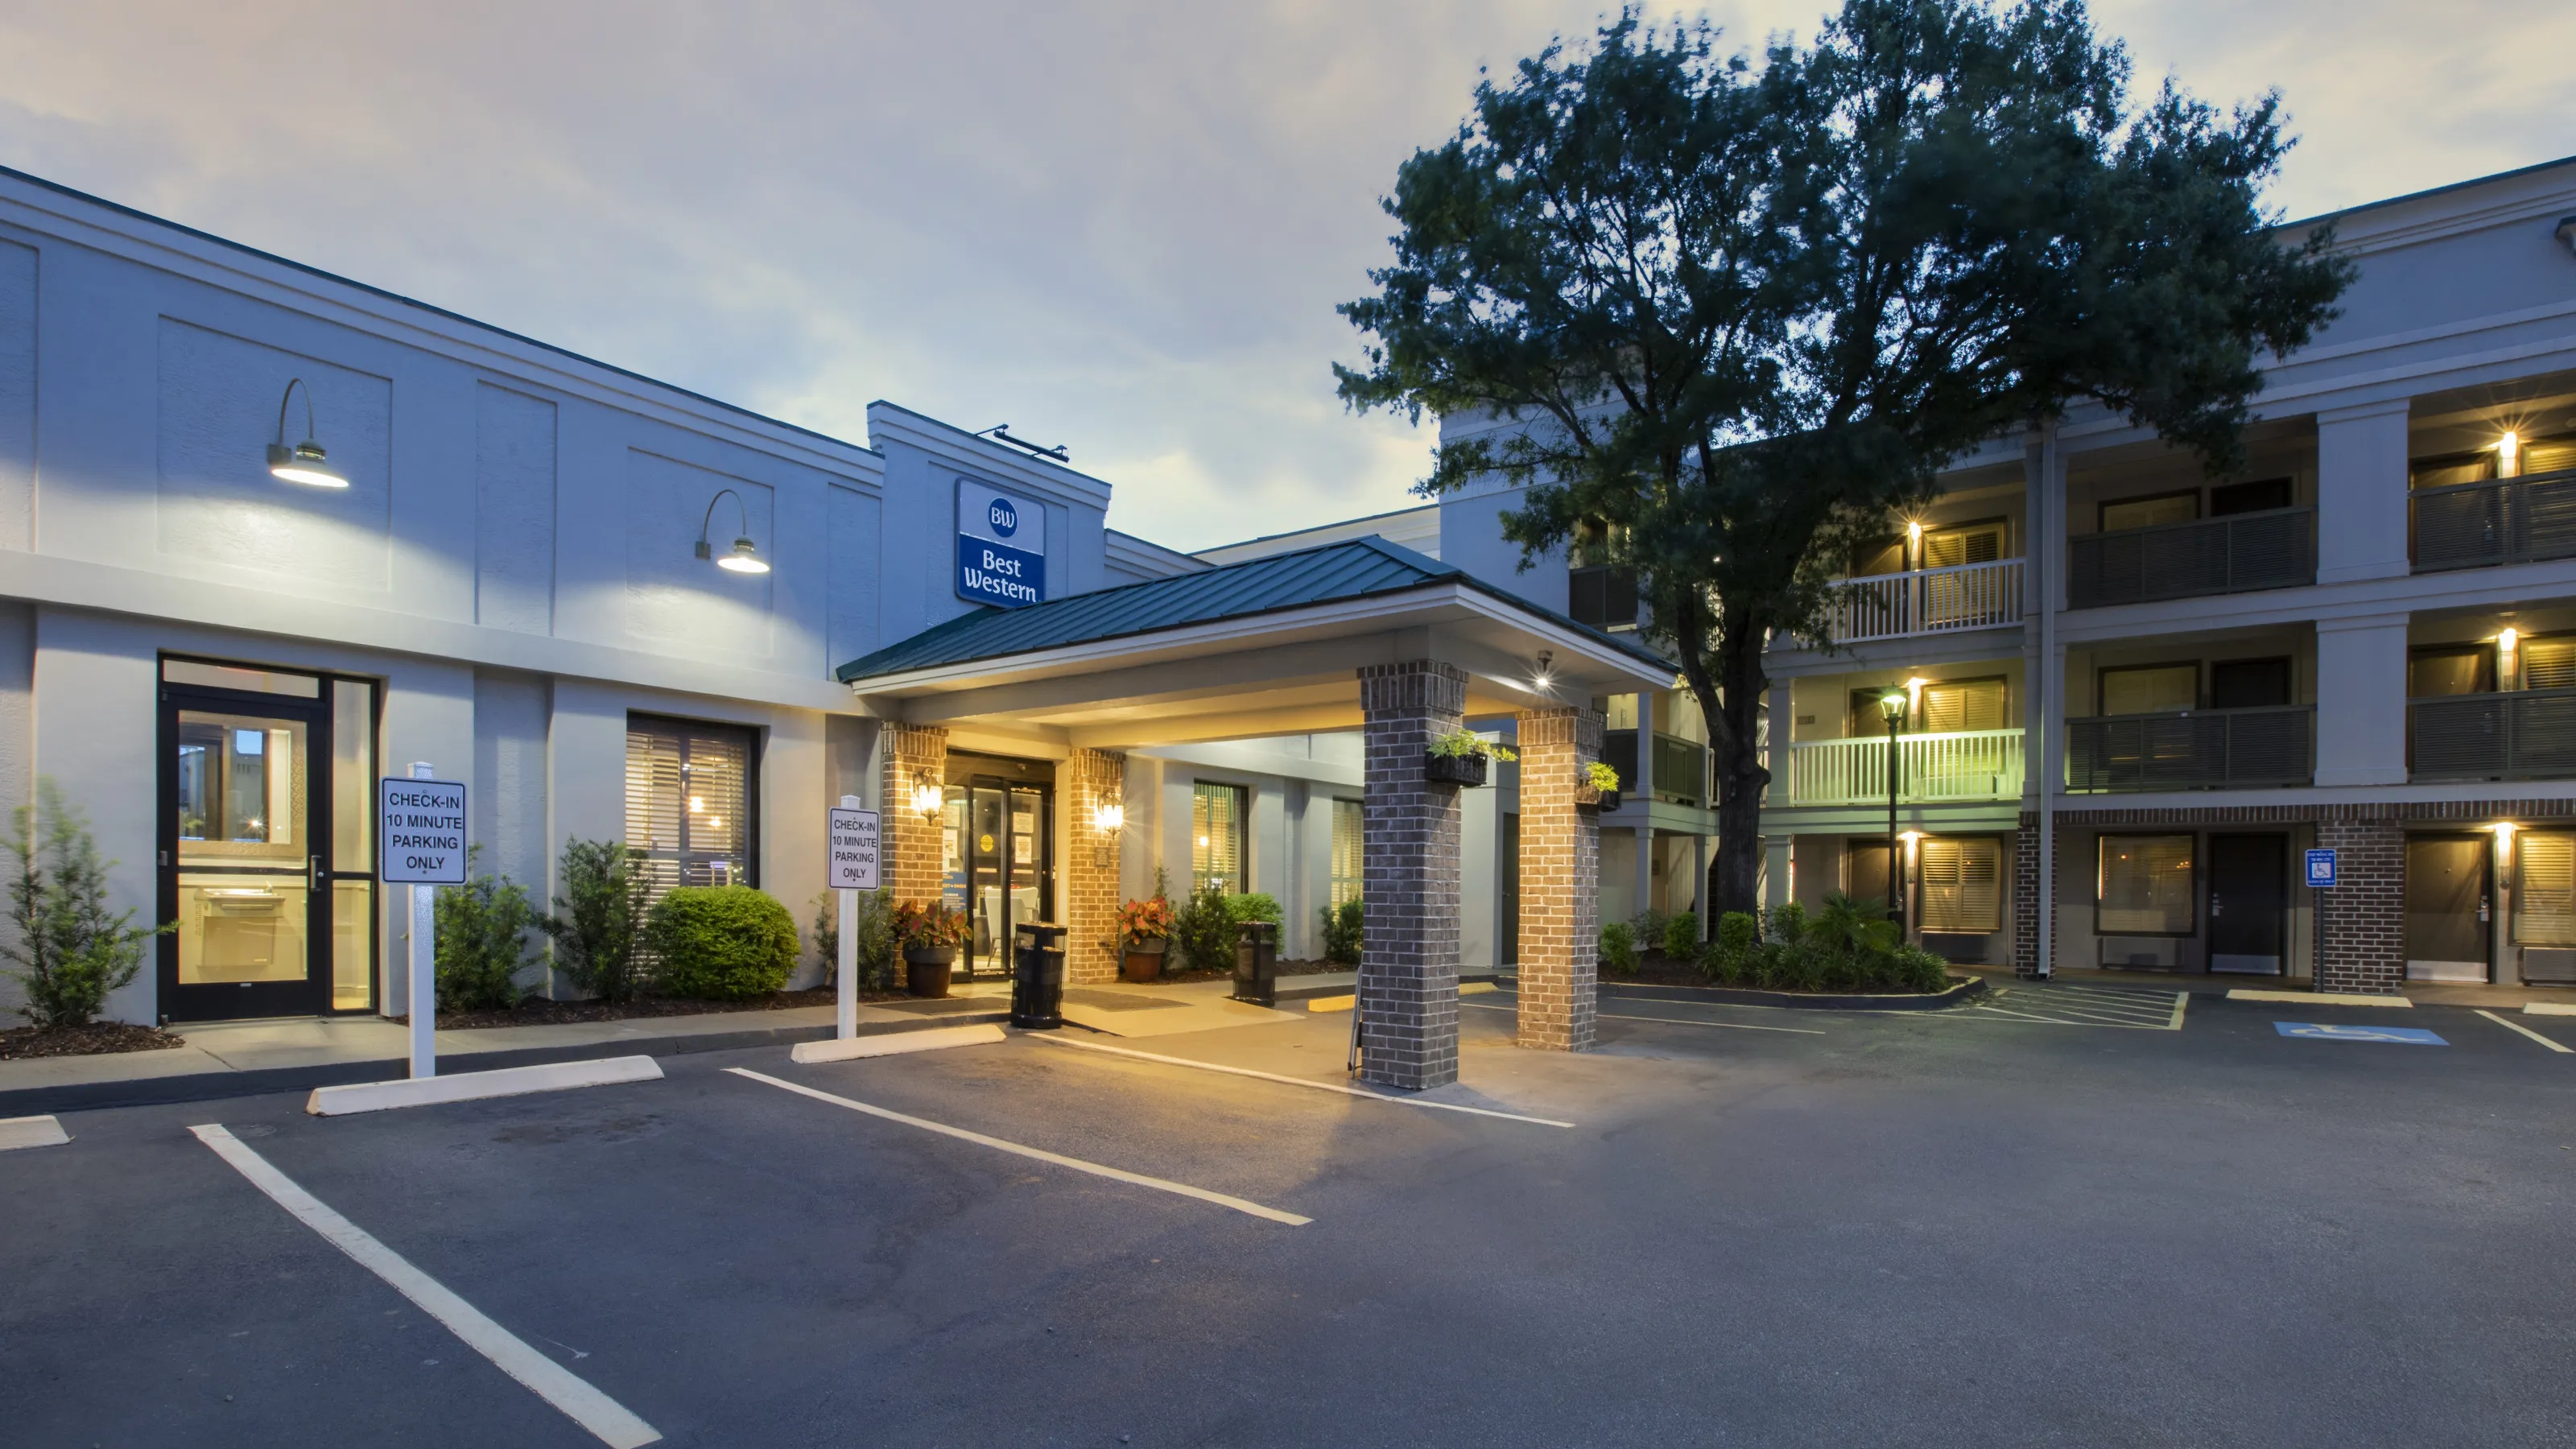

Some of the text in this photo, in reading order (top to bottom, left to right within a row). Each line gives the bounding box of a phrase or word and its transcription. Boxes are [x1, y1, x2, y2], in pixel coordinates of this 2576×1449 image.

[991, 507, 1015, 528] BW
[983, 549, 1022, 578] Best
[964, 567, 1037, 603] Western
[389, 792, 460, 809] CHECK-IN
[386, 814, 462, 830] 10 MINUTE
[834, 819, 876, 832] CHECK-IN
[392, 834, 458, 849] PARKING
[832, 836, 877, 848] 10 MINUTE
[406, 856, 445, 869] ONLY
[835, 851, 874, 863] PARKING
[843, 868, 866, 878] ONLY
